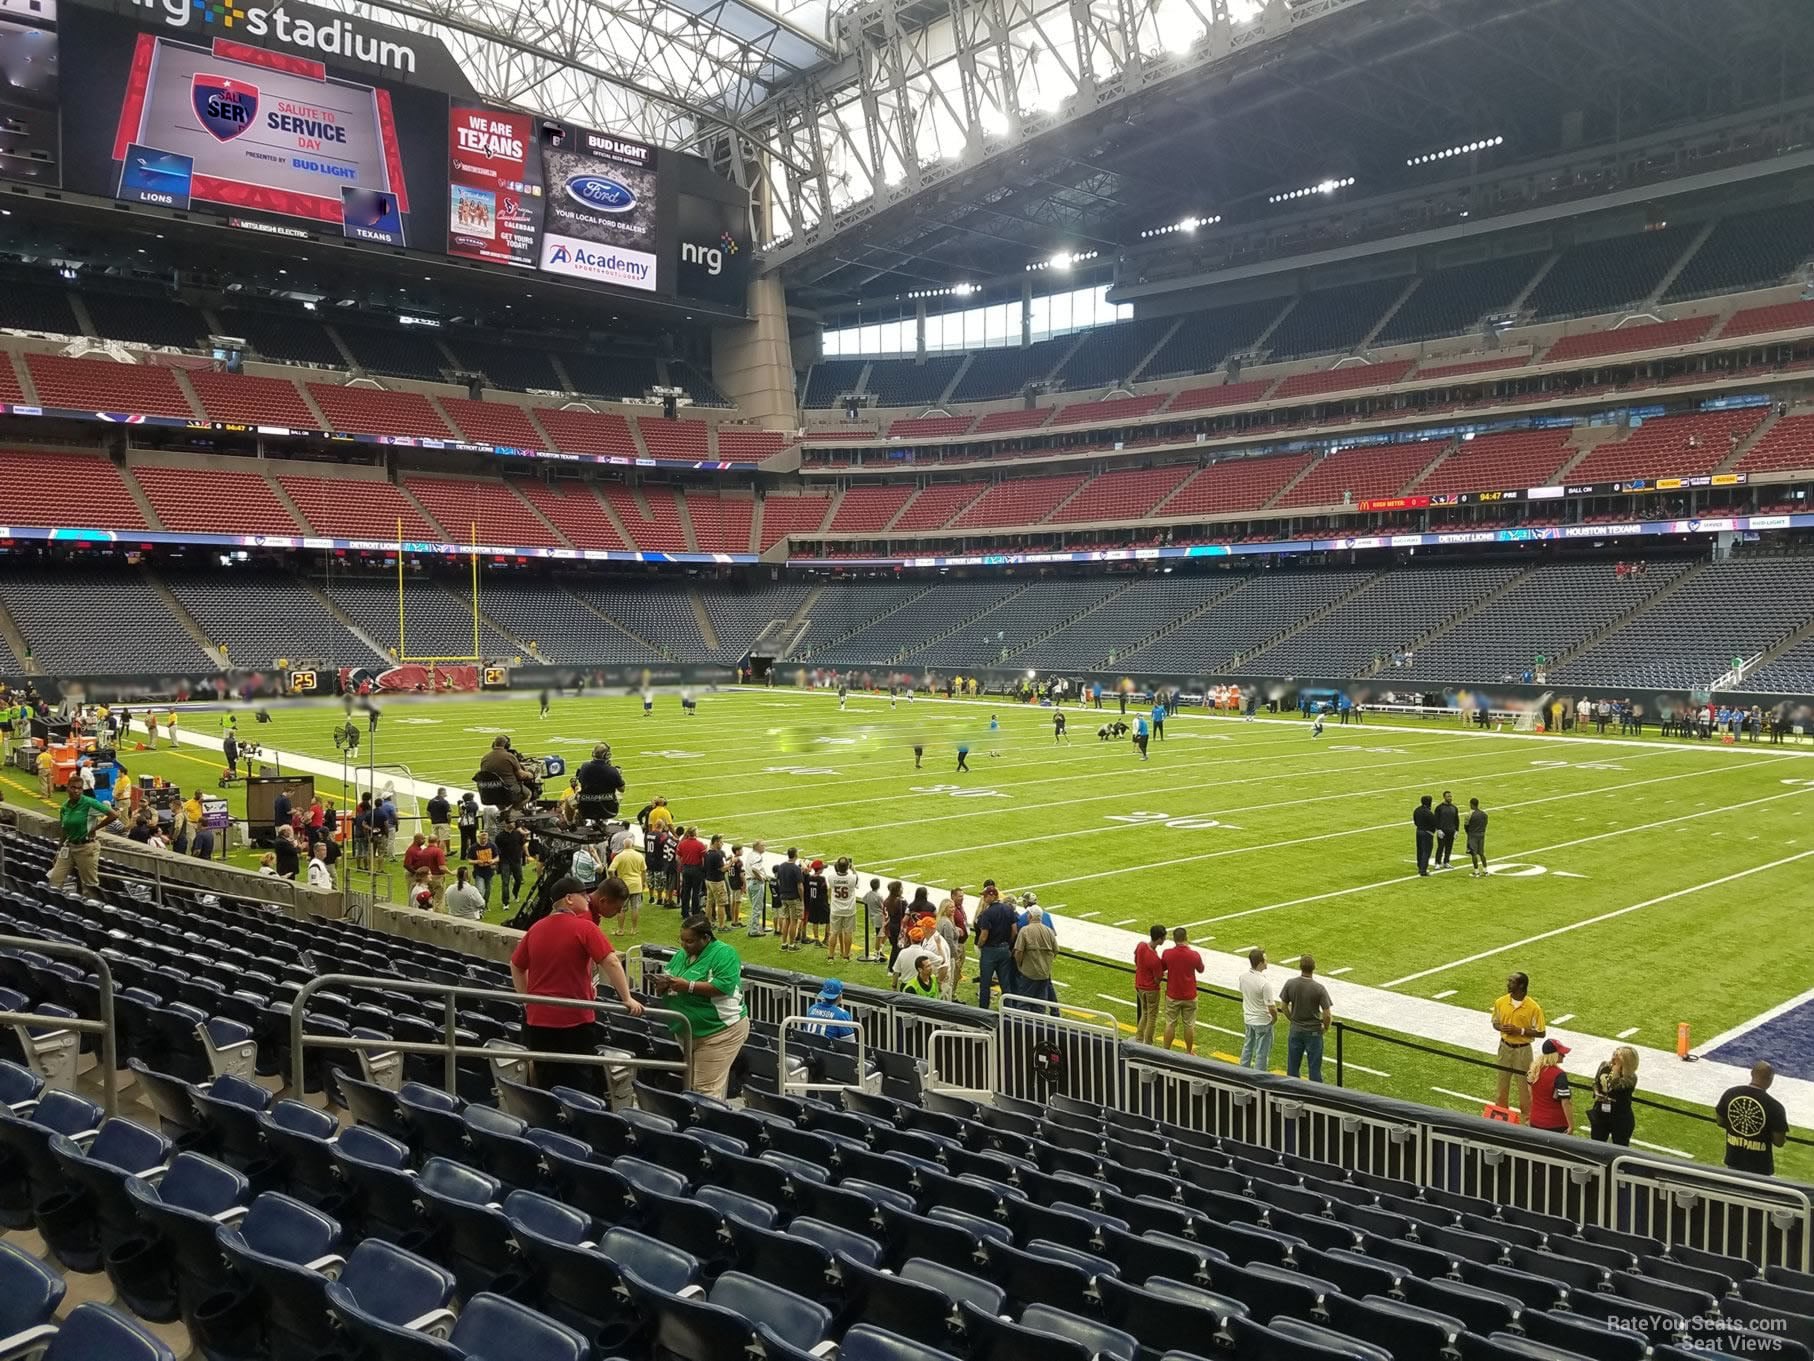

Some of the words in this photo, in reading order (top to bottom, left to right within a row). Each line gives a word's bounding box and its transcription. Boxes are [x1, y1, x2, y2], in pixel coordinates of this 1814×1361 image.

[246, 7, 415, 72] stadium
[278, 102, 319, 120] SALUTE
[321, 111, 336, 124] TO
[267, 112, 347, 144] SERVICE
[469, 115, 487, 131] WE
[490, 121, 512, 137] ARE
[298, 137, 321, 151] DAY
[457, 127, 523, 158] TEXANS
[588, 135, 613, 151] BUD
[614, 142, 647, 159] LIGHT
[245, 150, 277, 162] PRESENTED
[292, 158, 319, 172] BUD
[320, 163, 357, 179] LIGHT
[140, 191, 172, 204] LIONS
[583, 181, 620, 203] Ford
[555, 209, 575, 219] YOUR
[576, 213, 597, 224] LOCAL
[598, 218, 616, 228] FORD
[617, 222, 646, 234] DEALERS
[277, 226, 309, 239] ELECTRIC
[356, 228, 392, 243] TEXANS
[514, 235, 534, 245] YOURS
[575, 248, 648, 280] Academy
[682, 242, 722, 275] nrg
[1480, 492, 1502, 501] 94:47
[1438, 533, 1470, 543] DETROIT
[1471, 532, 1494, 541] LIONS
[1566, 526, 1606, 536] HOUSTON
[1608, 524, 1641, 534] TEXANS
[294, 673, 313, 688] 25
[487, 670, 501, 683] 25
[1104, 811, 1220, 829] 20
[647, 841, 654, 853] 10
[810, 887, 817, 899] 10
[834, 886, 849, 899] 56
